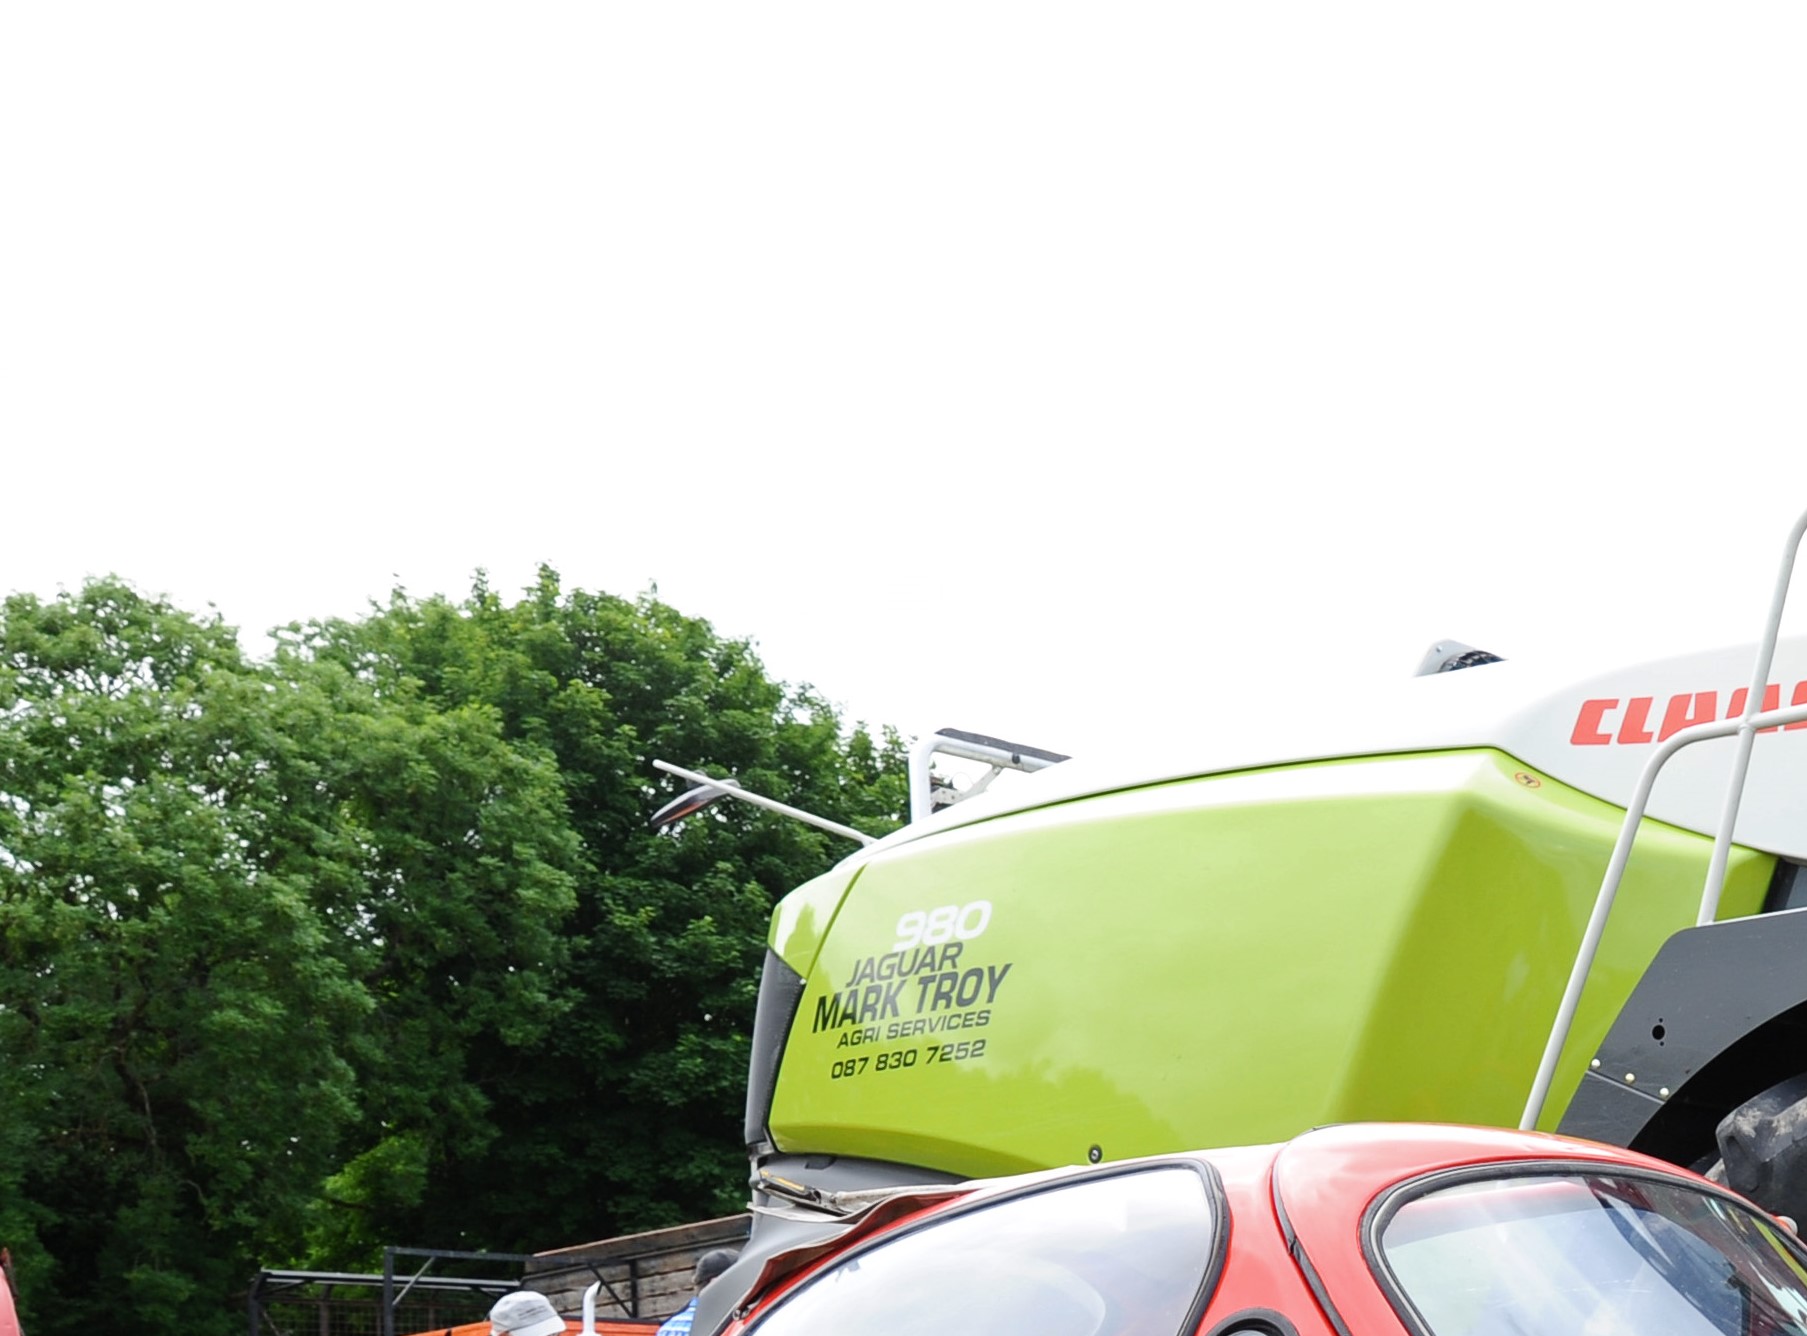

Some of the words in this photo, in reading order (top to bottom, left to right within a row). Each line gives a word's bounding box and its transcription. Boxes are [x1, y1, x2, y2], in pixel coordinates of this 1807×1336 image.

[892, 899, 993, 953] 980
[845, 941, 964, 989] JAGUAR
[811, 979, 908, 1034] MARK
[916, 962, 1014, 1014] TROY
[836, 1026, 881, 1049] AGRI
[886, 1009, 992, 1040] SERVICES
[830, 1056, 870, 1079] 087
[875, 1048, 918, 1072] 830
[925, 1039, 987, 1064] 7252
